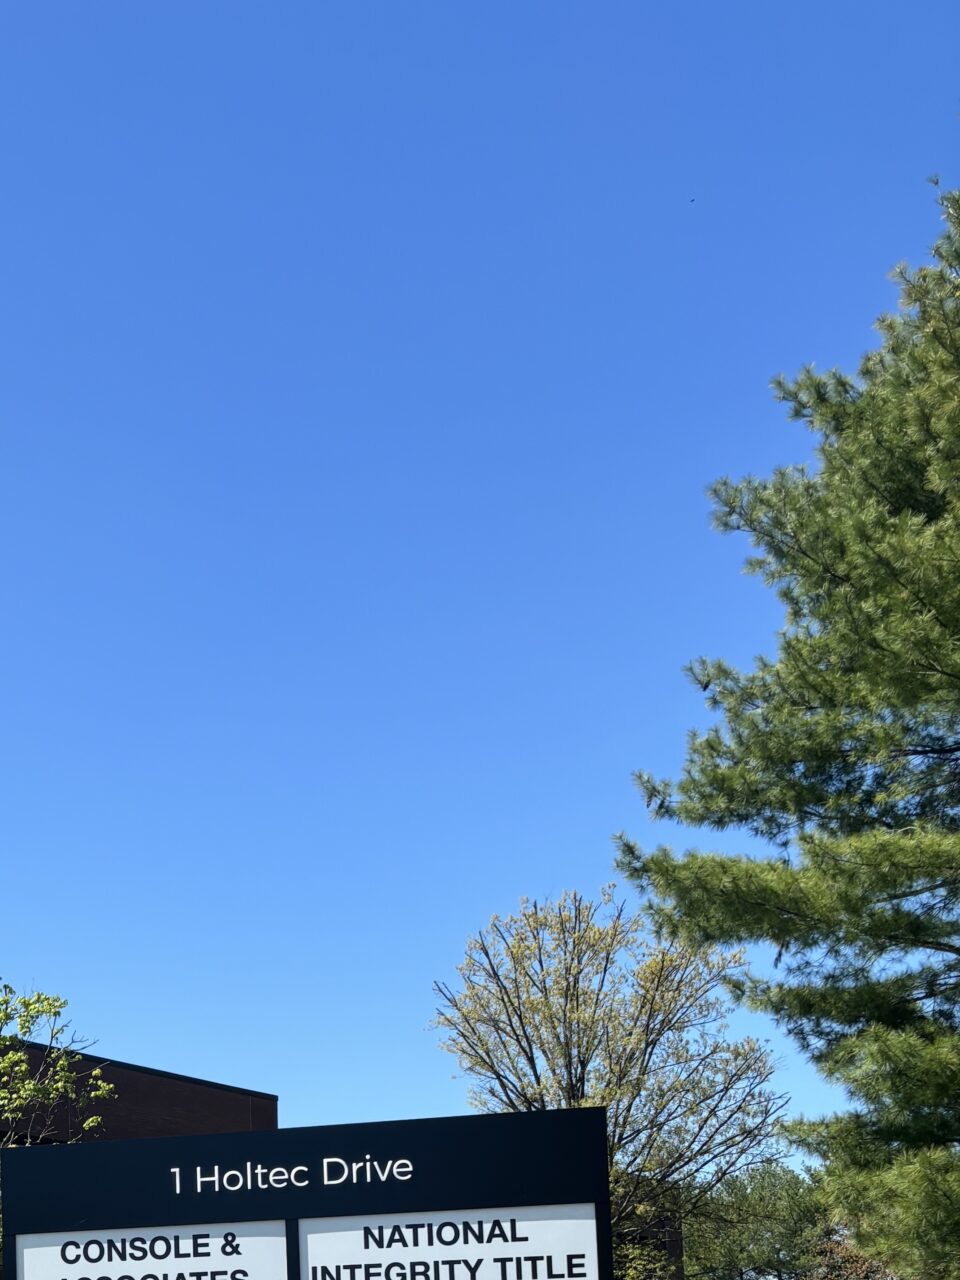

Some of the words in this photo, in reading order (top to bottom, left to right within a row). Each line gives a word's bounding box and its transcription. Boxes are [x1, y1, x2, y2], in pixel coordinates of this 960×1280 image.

[170, 1167, 181, 1194] 1
[196, 1162, 309, 1192] Holtec
[322, 1154, 413, 1185] Drive
[60, 1233, 211, 1265] CONSOLE
[220, 1231, 242, 1257] &
[362, 1218, 529, 1250] NATIONAL
